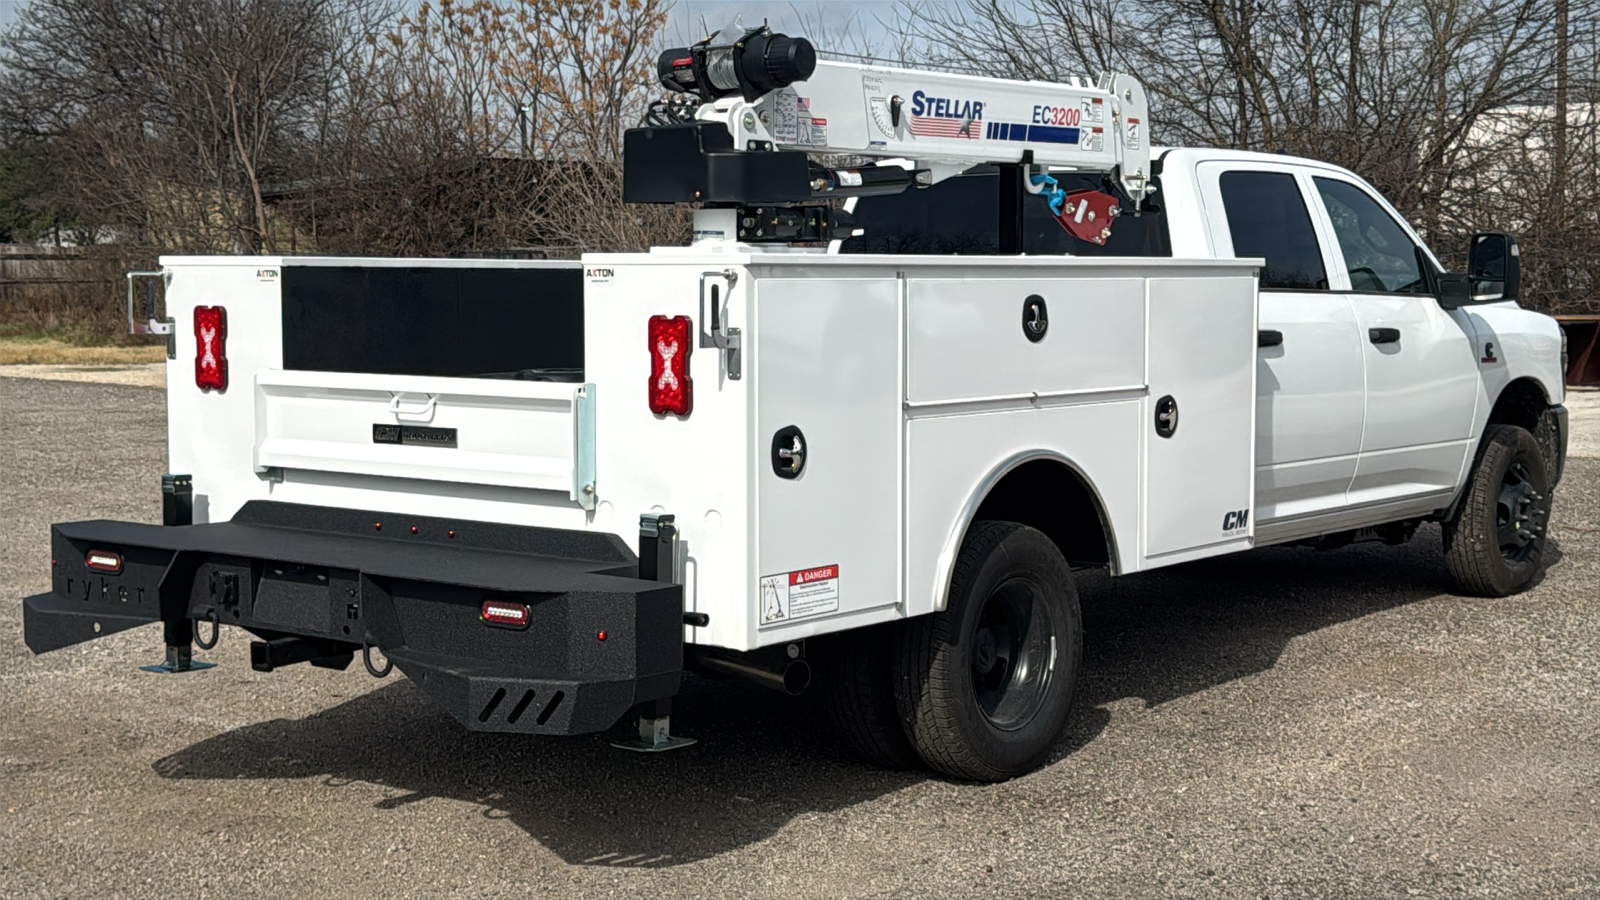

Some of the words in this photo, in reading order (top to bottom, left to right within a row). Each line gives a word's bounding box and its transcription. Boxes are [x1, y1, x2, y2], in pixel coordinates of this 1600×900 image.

[911, 90, 983, 120] STELLAR
[1032, 105, 1080, 127] EC3200
[256, 269, 279, 278] AXTON
[586, 268, 615, 278] AXTON
[1222, 509, 1249, 531] CM
[804, 568, 833, 582] DANGER
[67, 577, 145, 604] ryker
